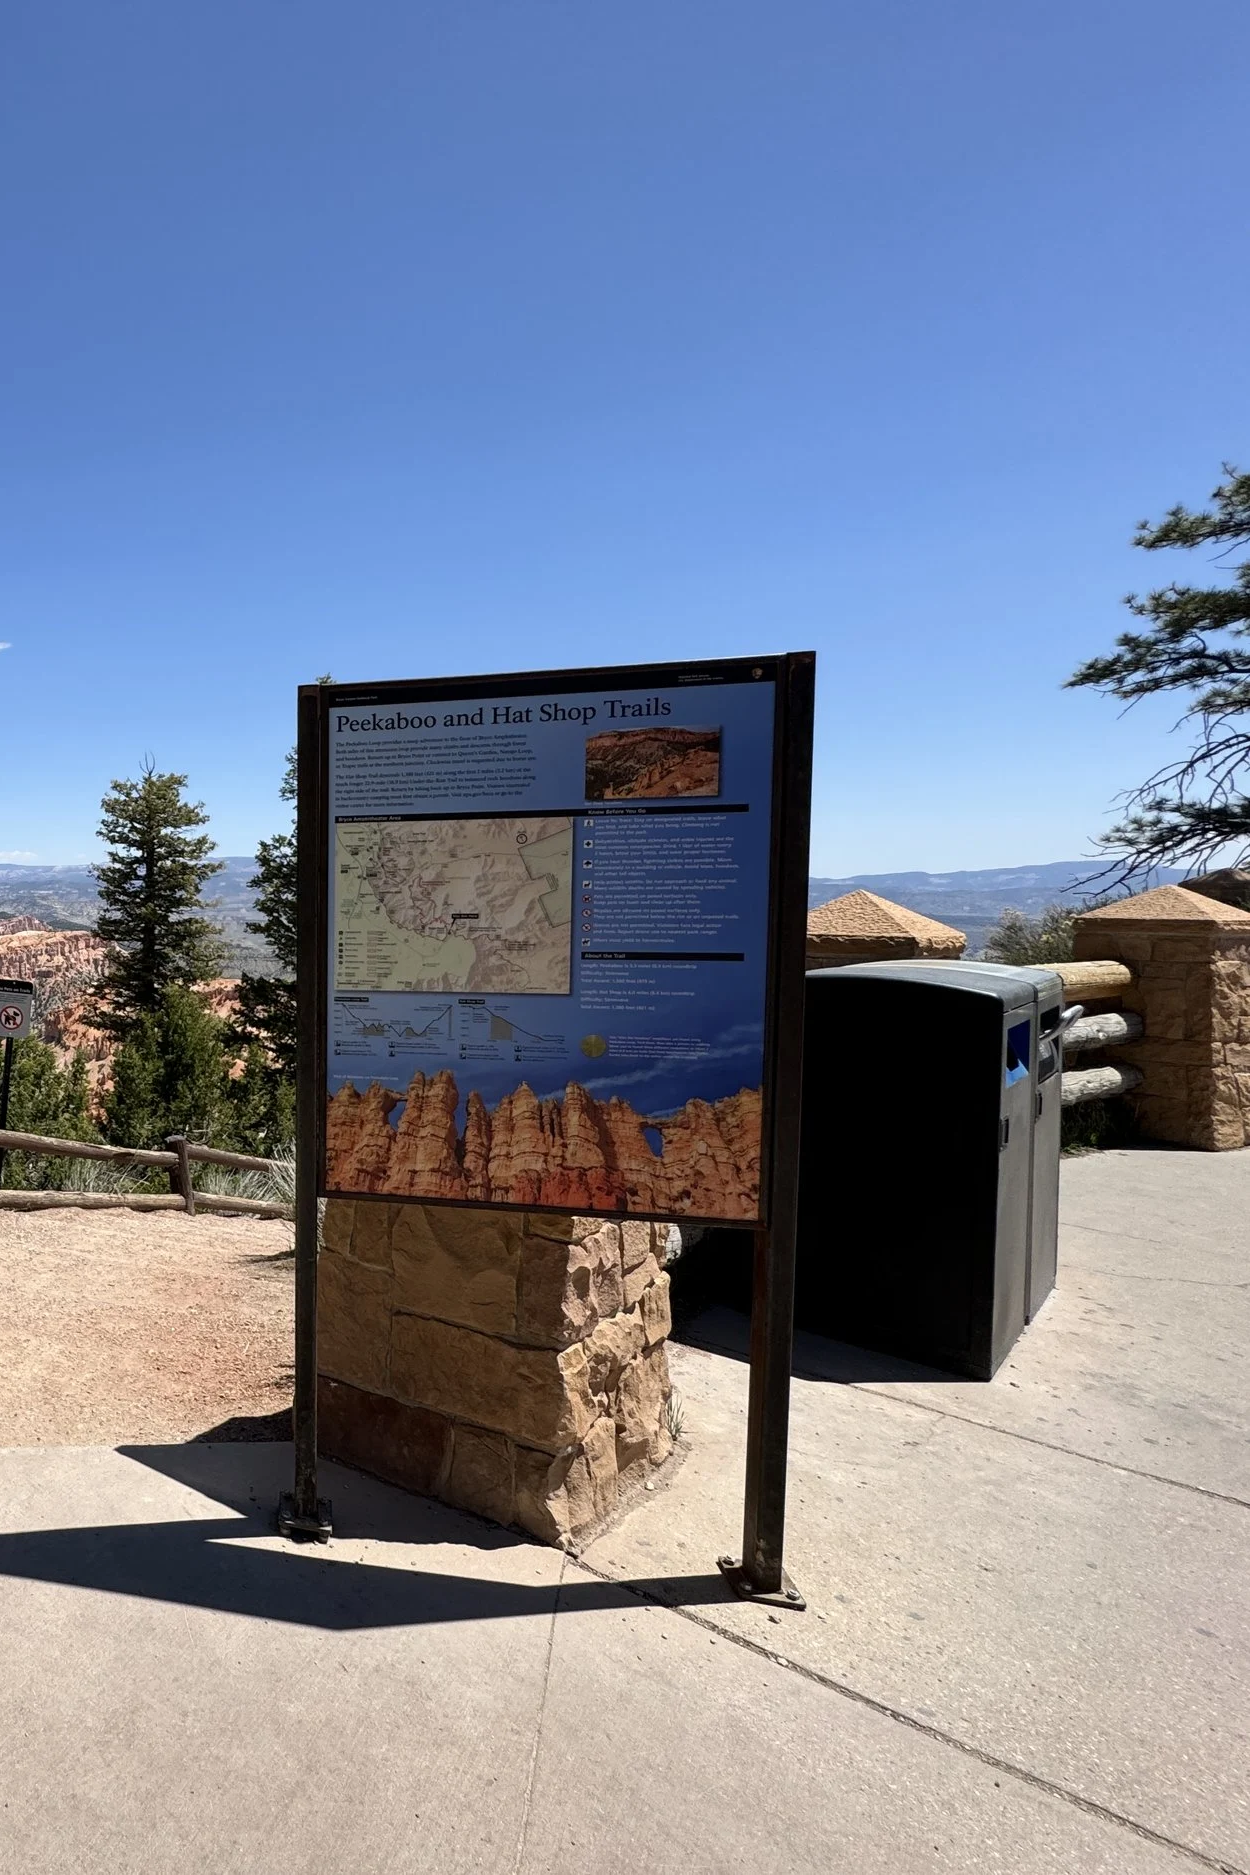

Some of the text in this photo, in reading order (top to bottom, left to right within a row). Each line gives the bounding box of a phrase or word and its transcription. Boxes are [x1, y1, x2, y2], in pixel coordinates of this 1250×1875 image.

[336, 697, 671, 732] Peekaboo and Hat Shop Trails
